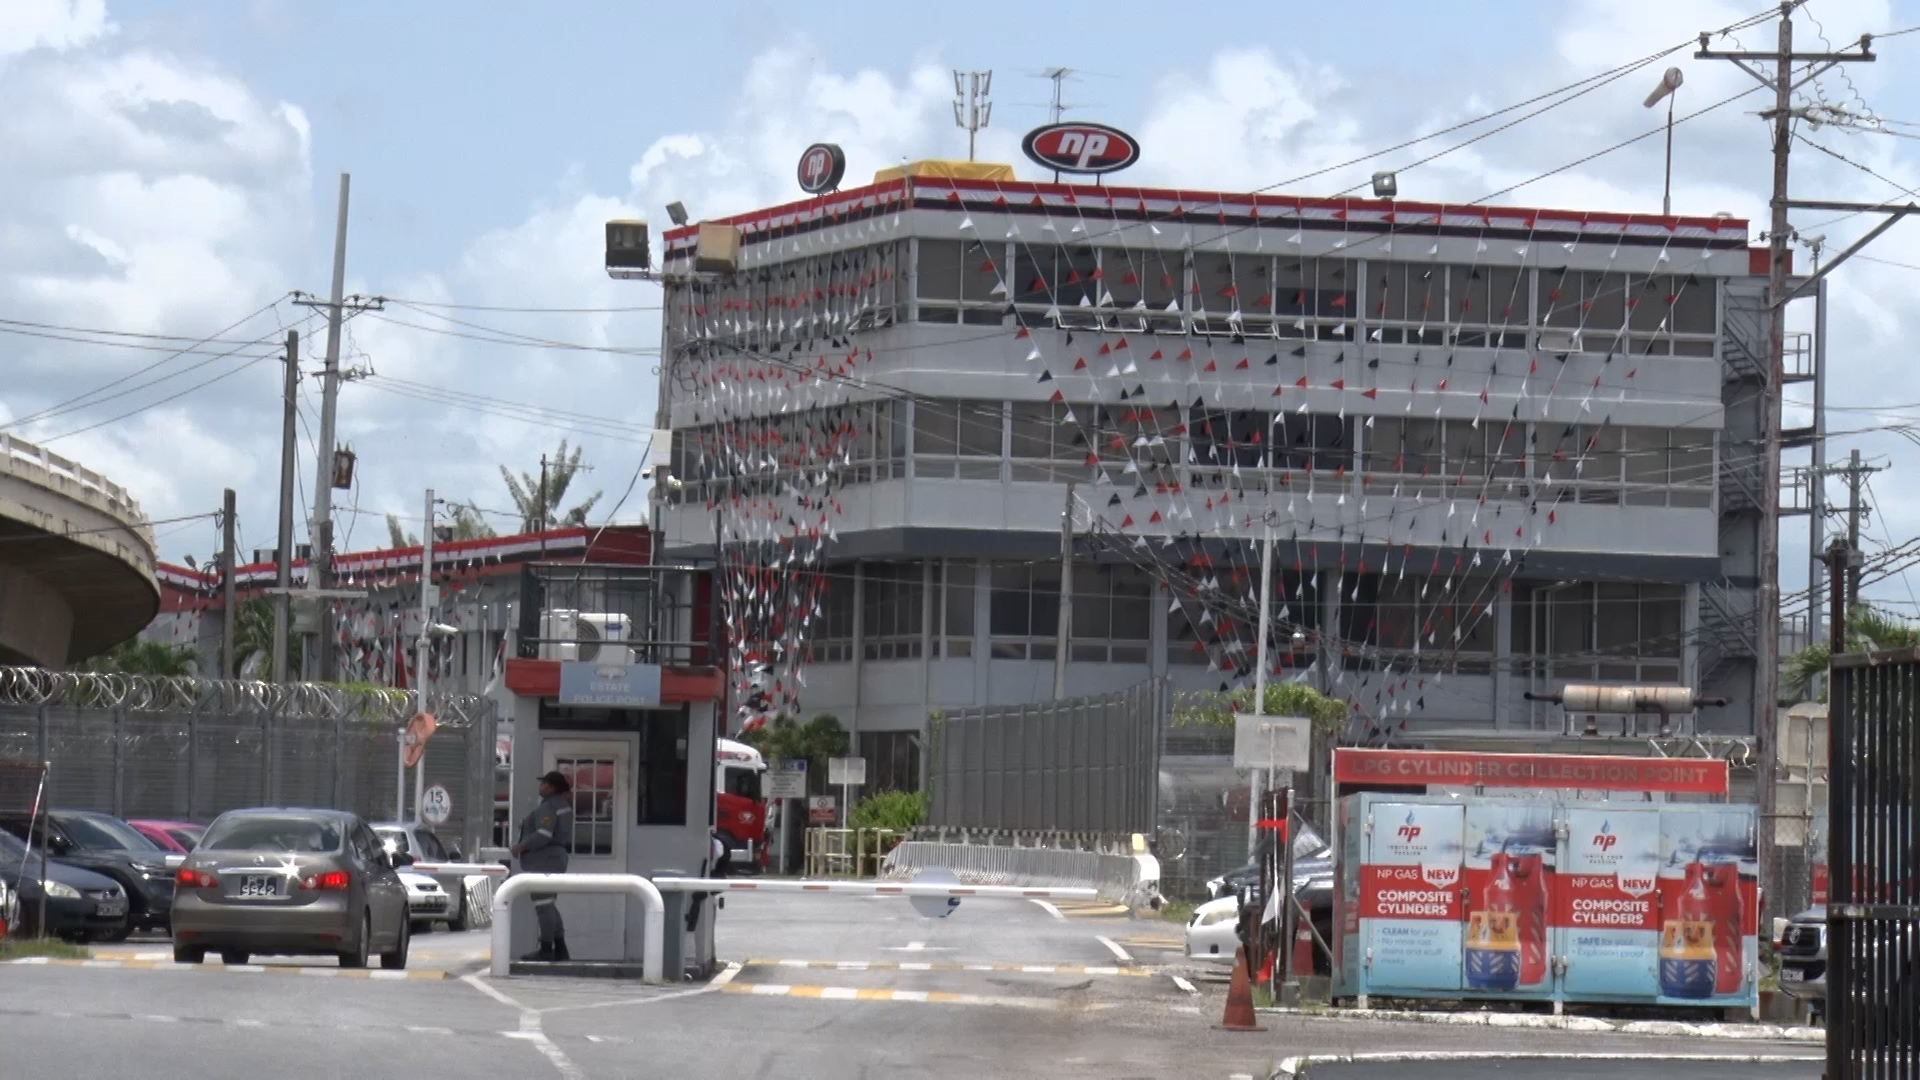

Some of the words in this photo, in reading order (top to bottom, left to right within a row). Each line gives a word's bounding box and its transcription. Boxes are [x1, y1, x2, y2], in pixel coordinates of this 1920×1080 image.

[1057, 132, 1109, 170] np
[808, 153, 824, 188] np
[590, 682, 631, 693] ESTATE
[574, 693, 614, 704] POLICE
[1352, 758, 1392, 776] LPG
[1397, 759, 1501, 777] CYLINDER
[1507, 761, 1638, 782] COLLECTION
[1643, 765, 1708, 784] POINT
[430, 791, 444, 804] 15
[1397, 824, 1422, 844] np
[1592, 834, 1617, 852] np
[1376, 869, 1393, 879] NP
[1395, 869, 1419, 880] GAS
[1427, 869, 1456, 881] NEW
[1571, 877, 1588, 888] NP
[1589, 877, 1614, 889] GAS
[1622, 879, 1653, 890] NEW
[1377, 889, 1454, 903] COMPOSITE
[1377, 902, 1448, 917] CYLINDERS
[1572, 898, 1650, 913] COMPOSITE
[1572, 911, 1645, 925] CYLINDERS
[1382, 927, 1409, 936] CLEAN
[1577, 937, 1600, 946] SAFE
